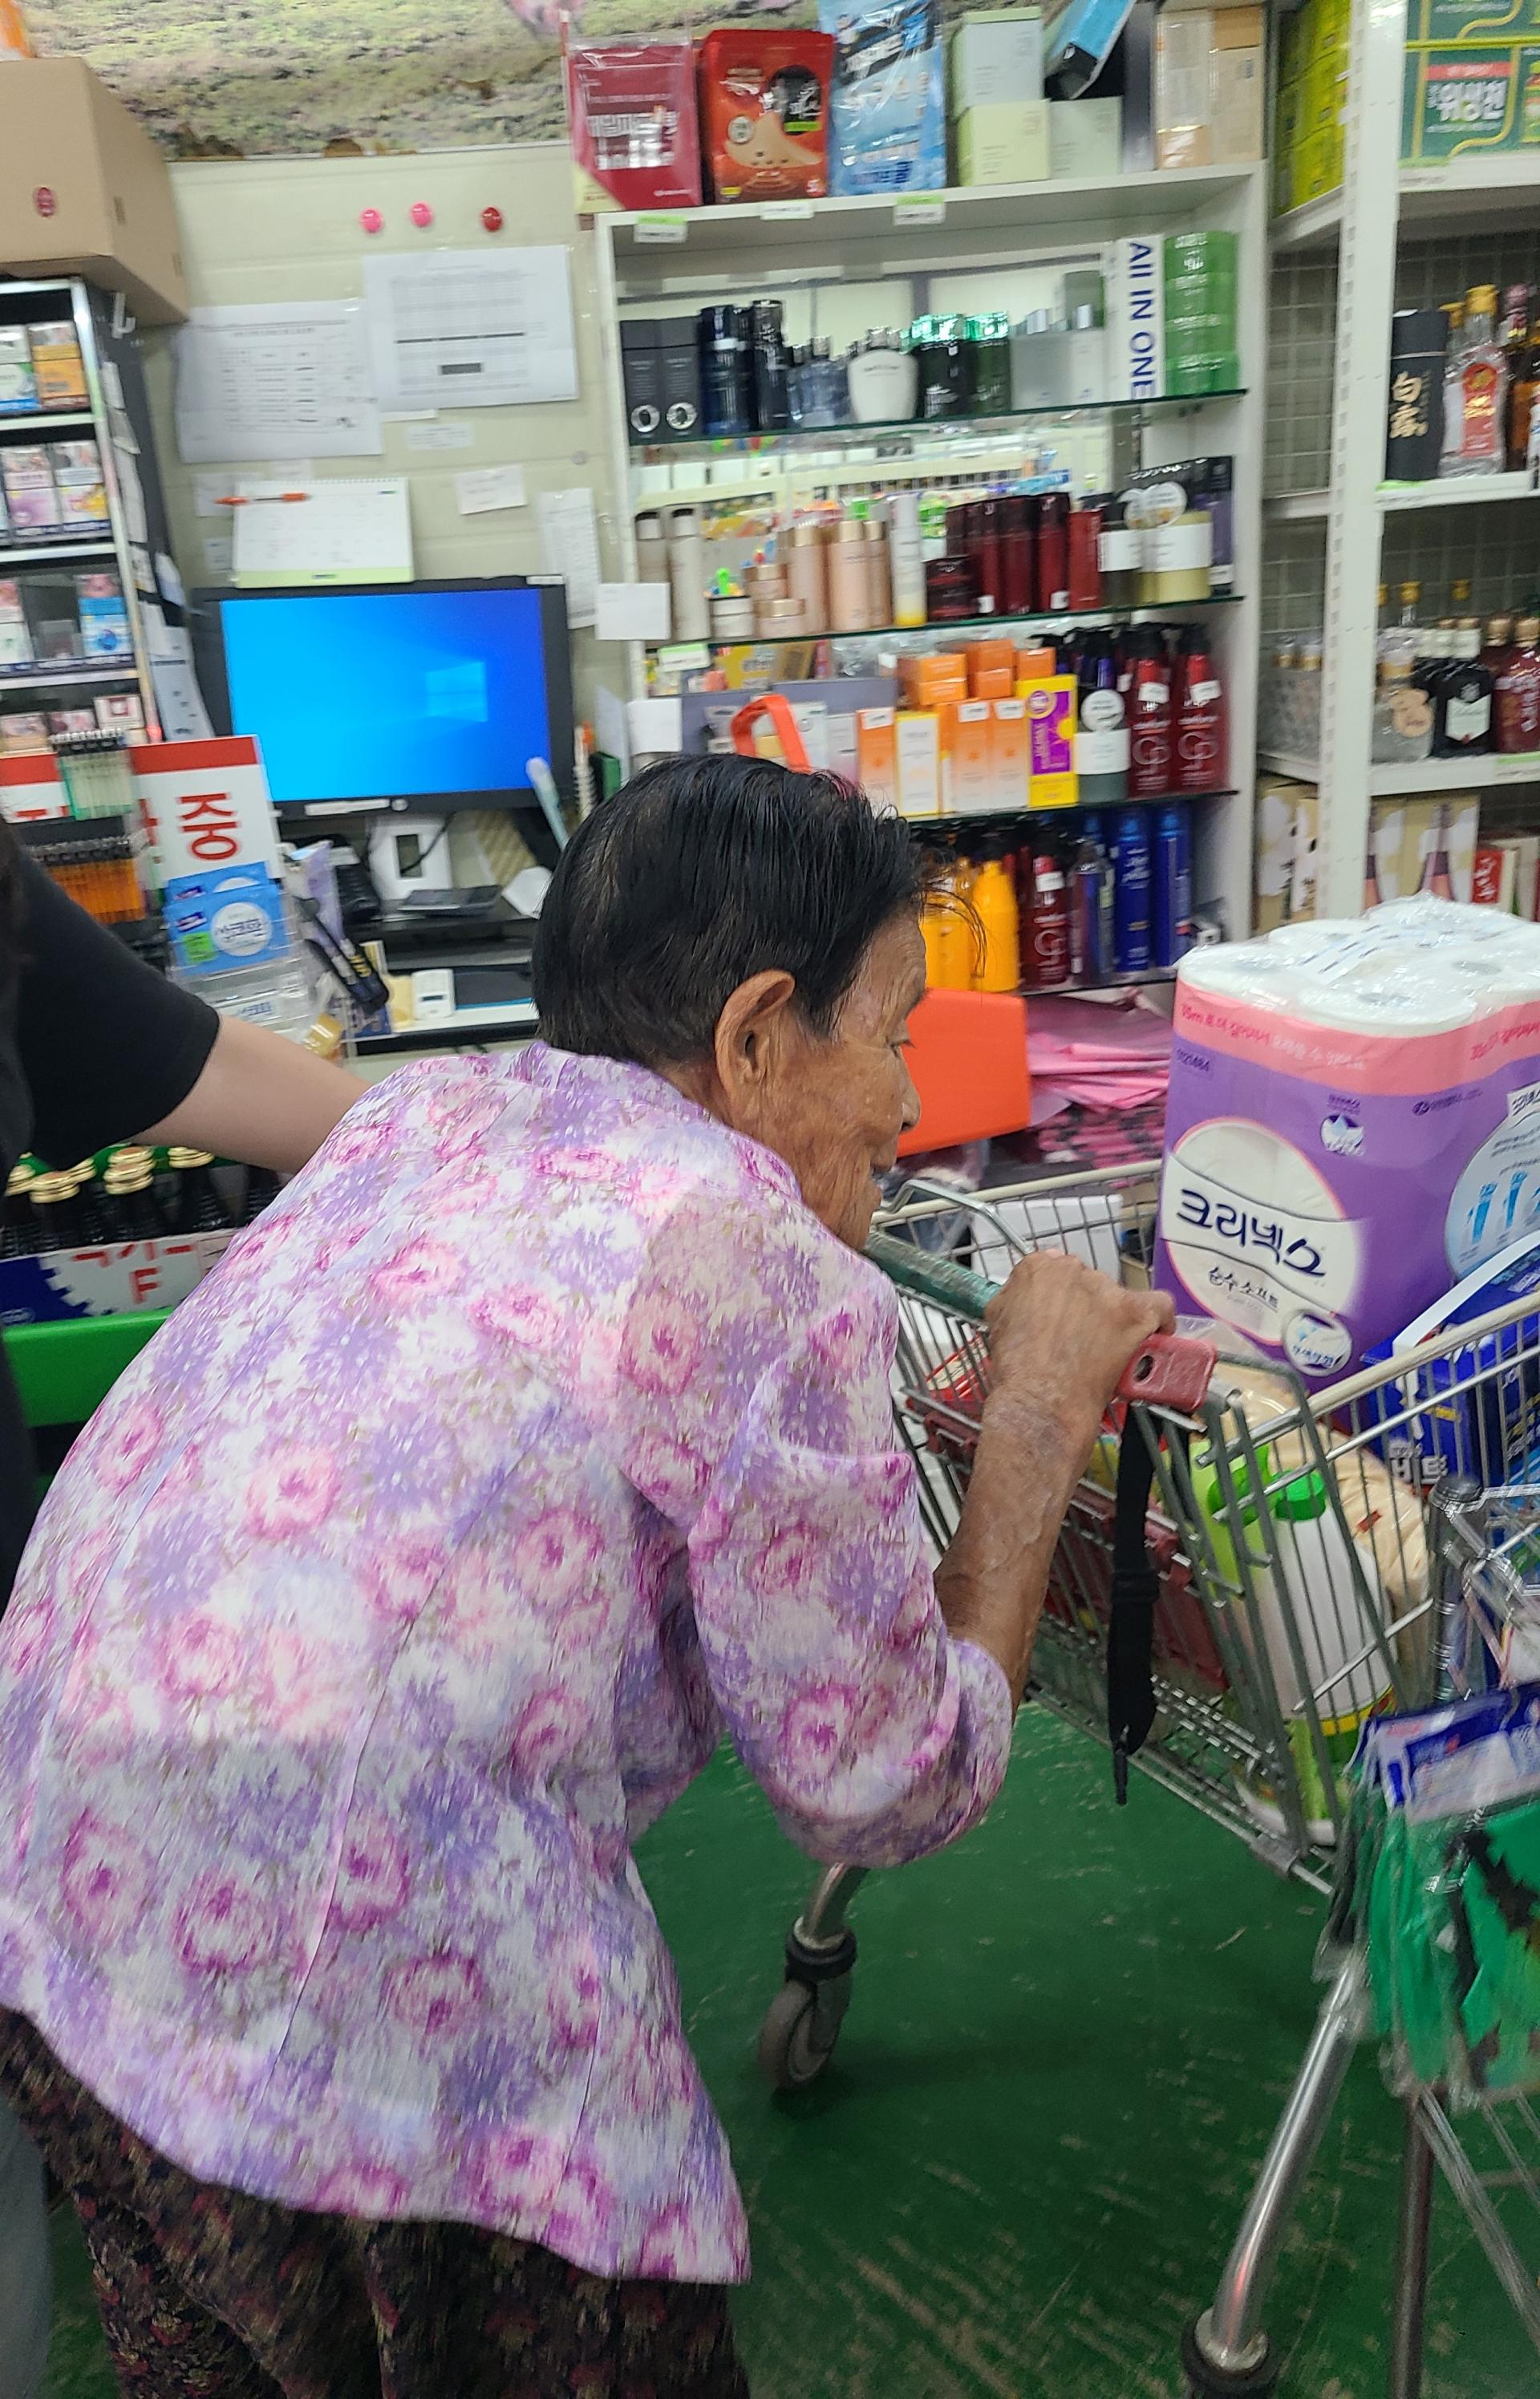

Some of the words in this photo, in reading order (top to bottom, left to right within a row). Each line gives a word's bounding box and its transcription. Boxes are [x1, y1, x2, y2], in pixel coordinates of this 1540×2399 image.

[1129, 290, 1153, 320] IN
[1129, 332, 1156, 399] ONE
[176, 792, 239, 860] 중
[1176, 1189, 1326, 1277] 크리넥스
